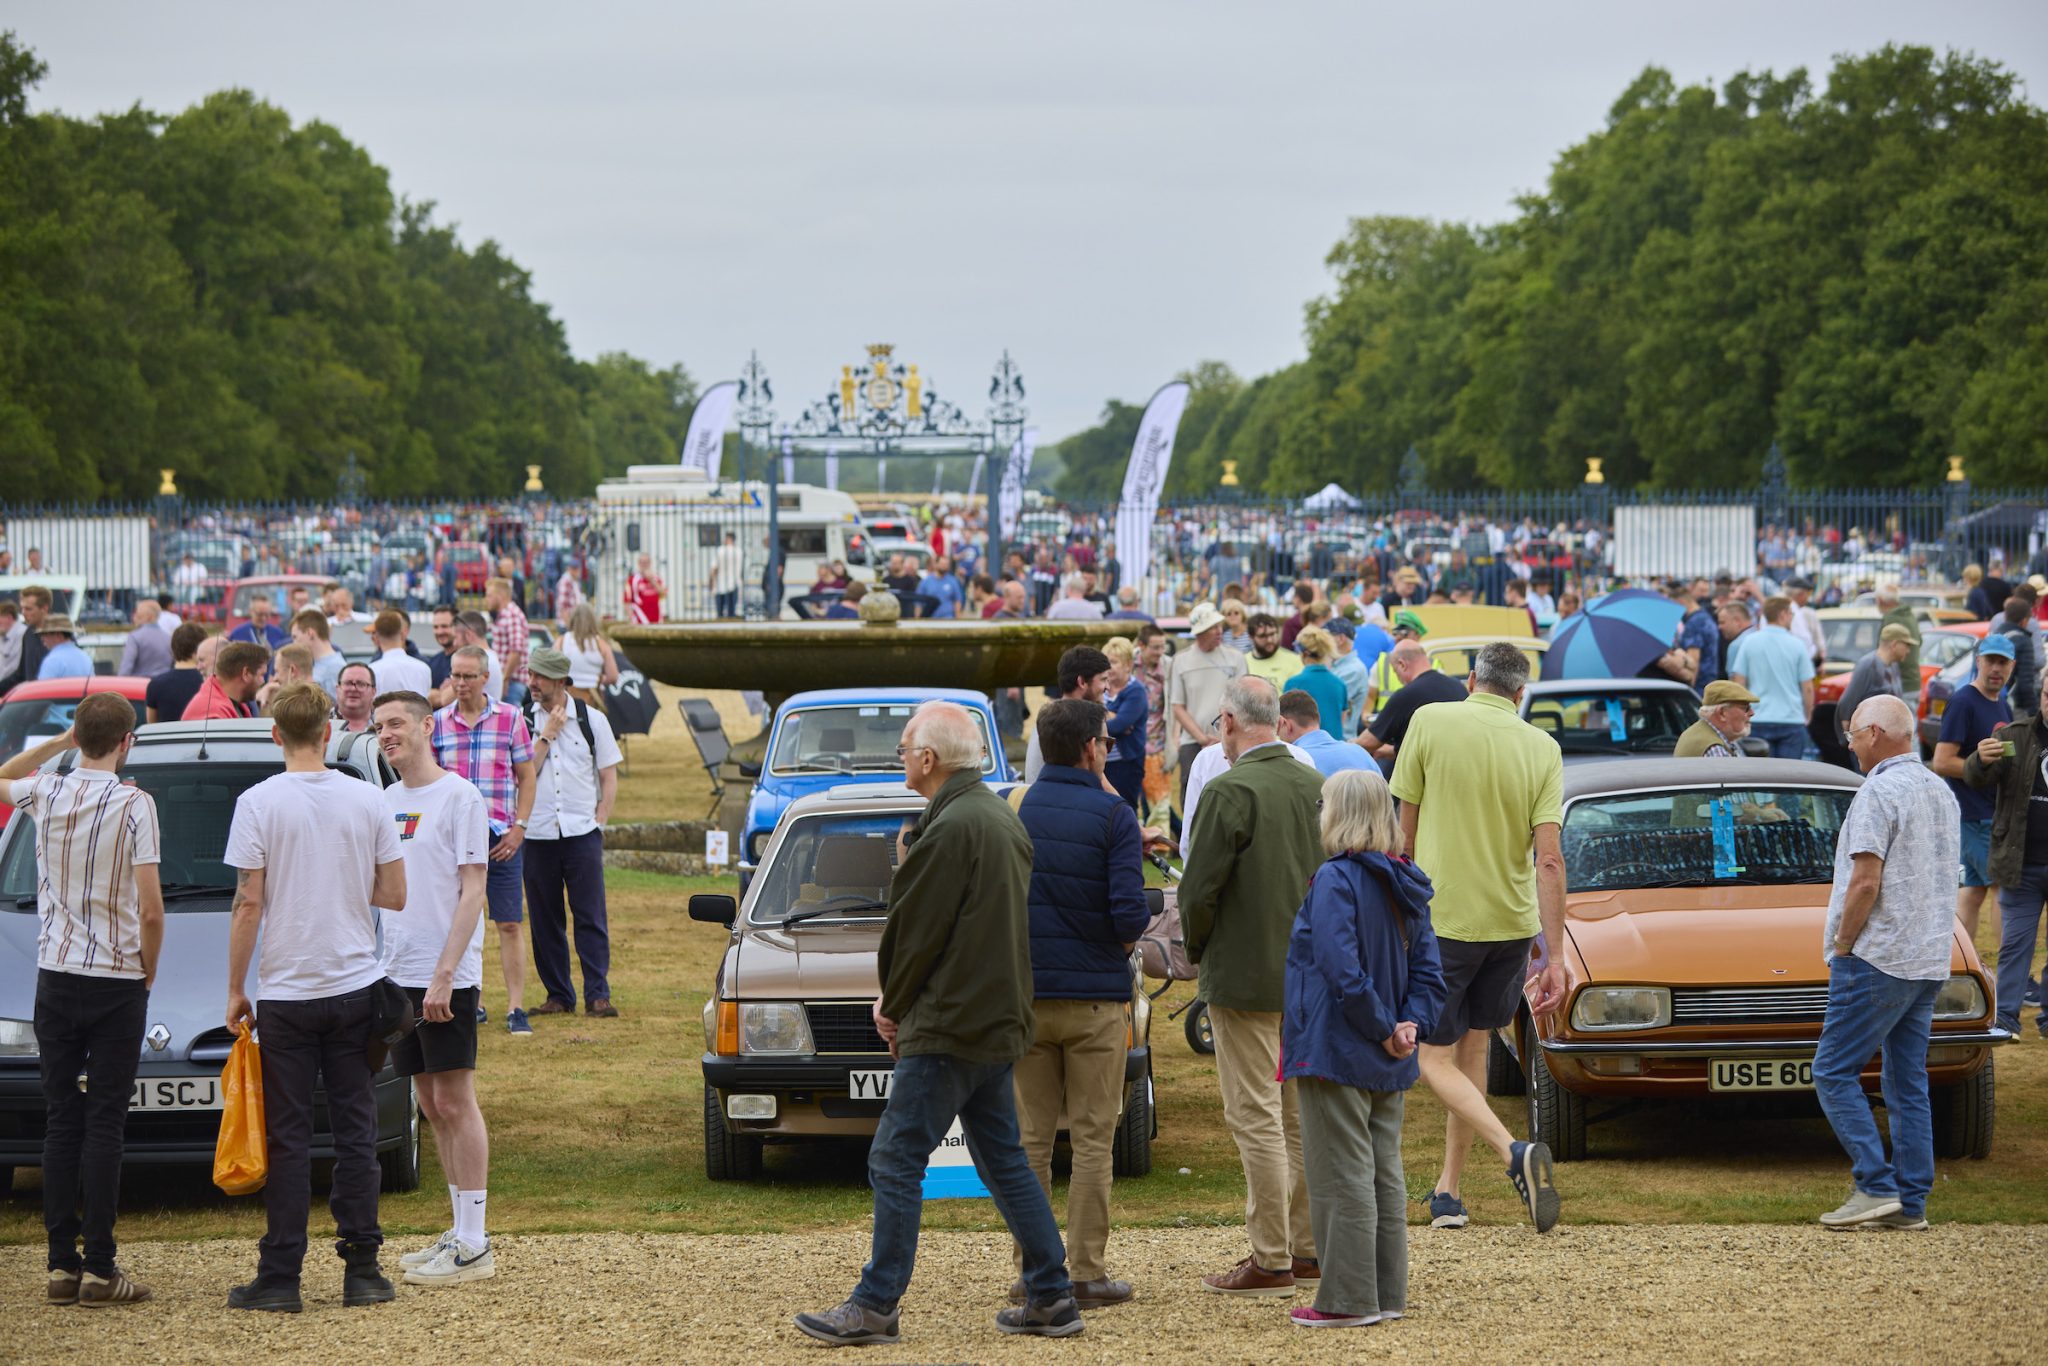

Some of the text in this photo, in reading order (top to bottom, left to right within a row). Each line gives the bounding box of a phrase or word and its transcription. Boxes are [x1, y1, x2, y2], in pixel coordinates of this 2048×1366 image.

[851, 1072, 895, 1098] YV
[1717, 1061, 1814, 1087] USE 60
[156, 1080, 215, 1106] SCJ
